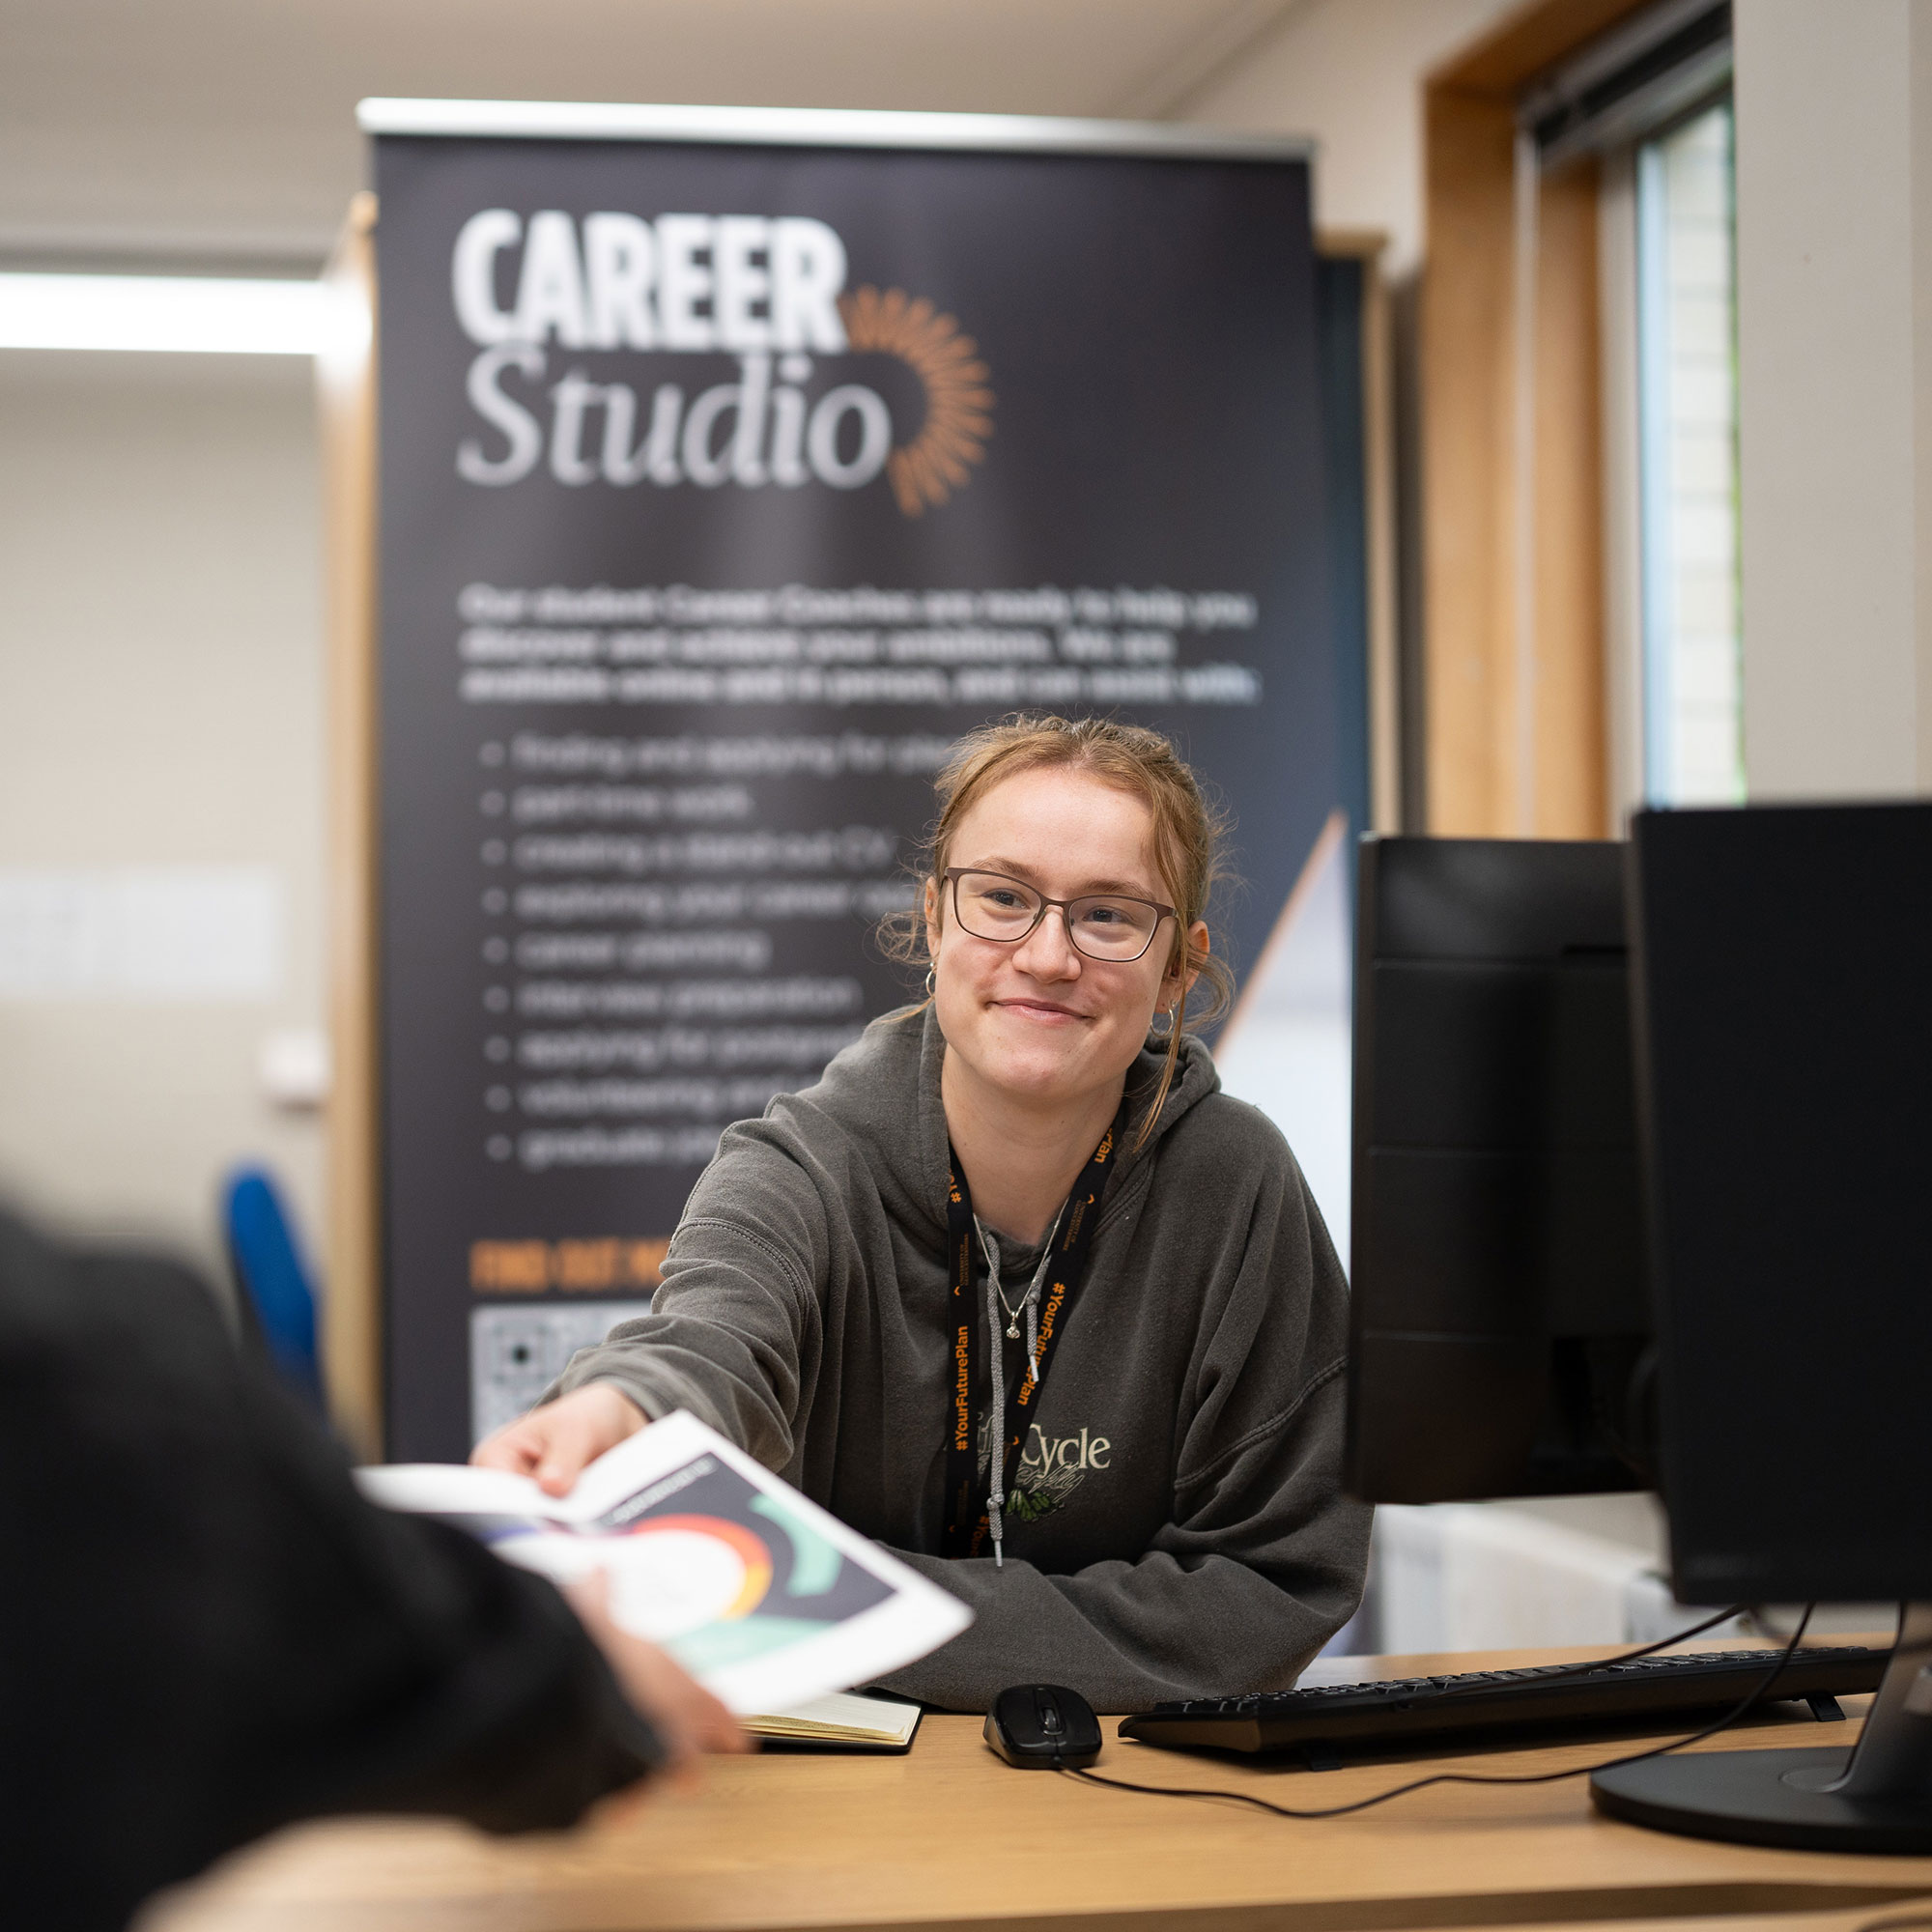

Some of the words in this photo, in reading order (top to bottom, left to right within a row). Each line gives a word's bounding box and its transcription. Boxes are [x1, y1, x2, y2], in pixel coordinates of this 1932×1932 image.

[454, 209, 849, 354] CAREER
[457, 345, 894, 487] Studio
[463, 587, 527, 619] Our
[532, 587, 658, 619] student
[665, 587, 774, 619] Career
[1119, 588, 1186, 628] help
[1193, 595, 1253, 629] you
[955, 1325, 969, 1451] #YourFuturePlan
